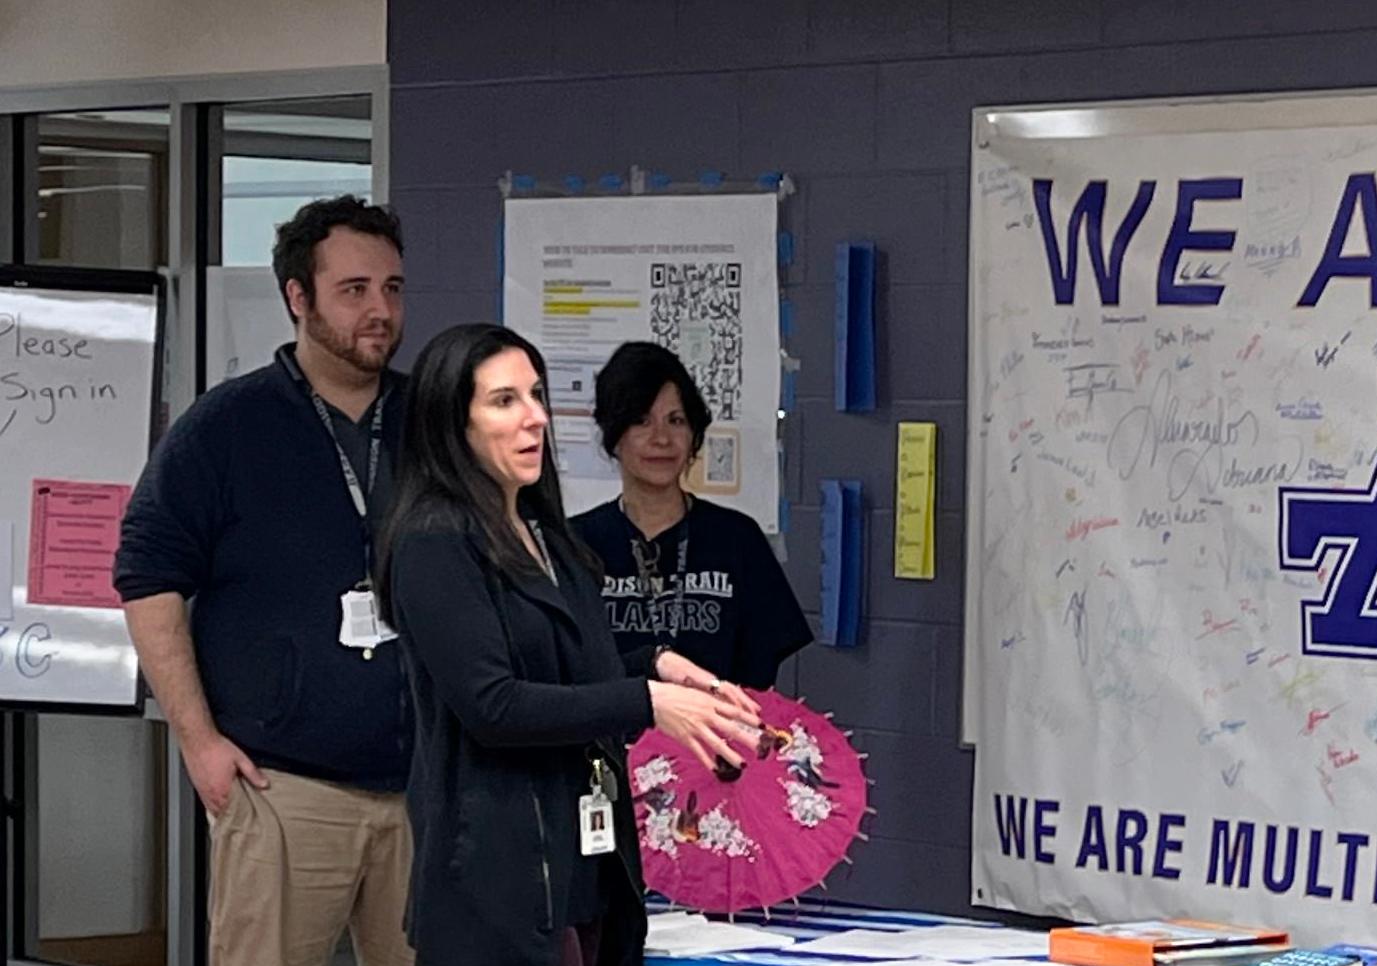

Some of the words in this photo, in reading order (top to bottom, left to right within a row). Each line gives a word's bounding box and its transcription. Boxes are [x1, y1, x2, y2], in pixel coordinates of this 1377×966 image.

[1032, 178, 1244, 306] WE
[0, 371, 77, 425] Sign
[90, 378, 117, 400] in
[993, 793, 1060, 865] WE
[1075, 804, 1187, 880] ARE
